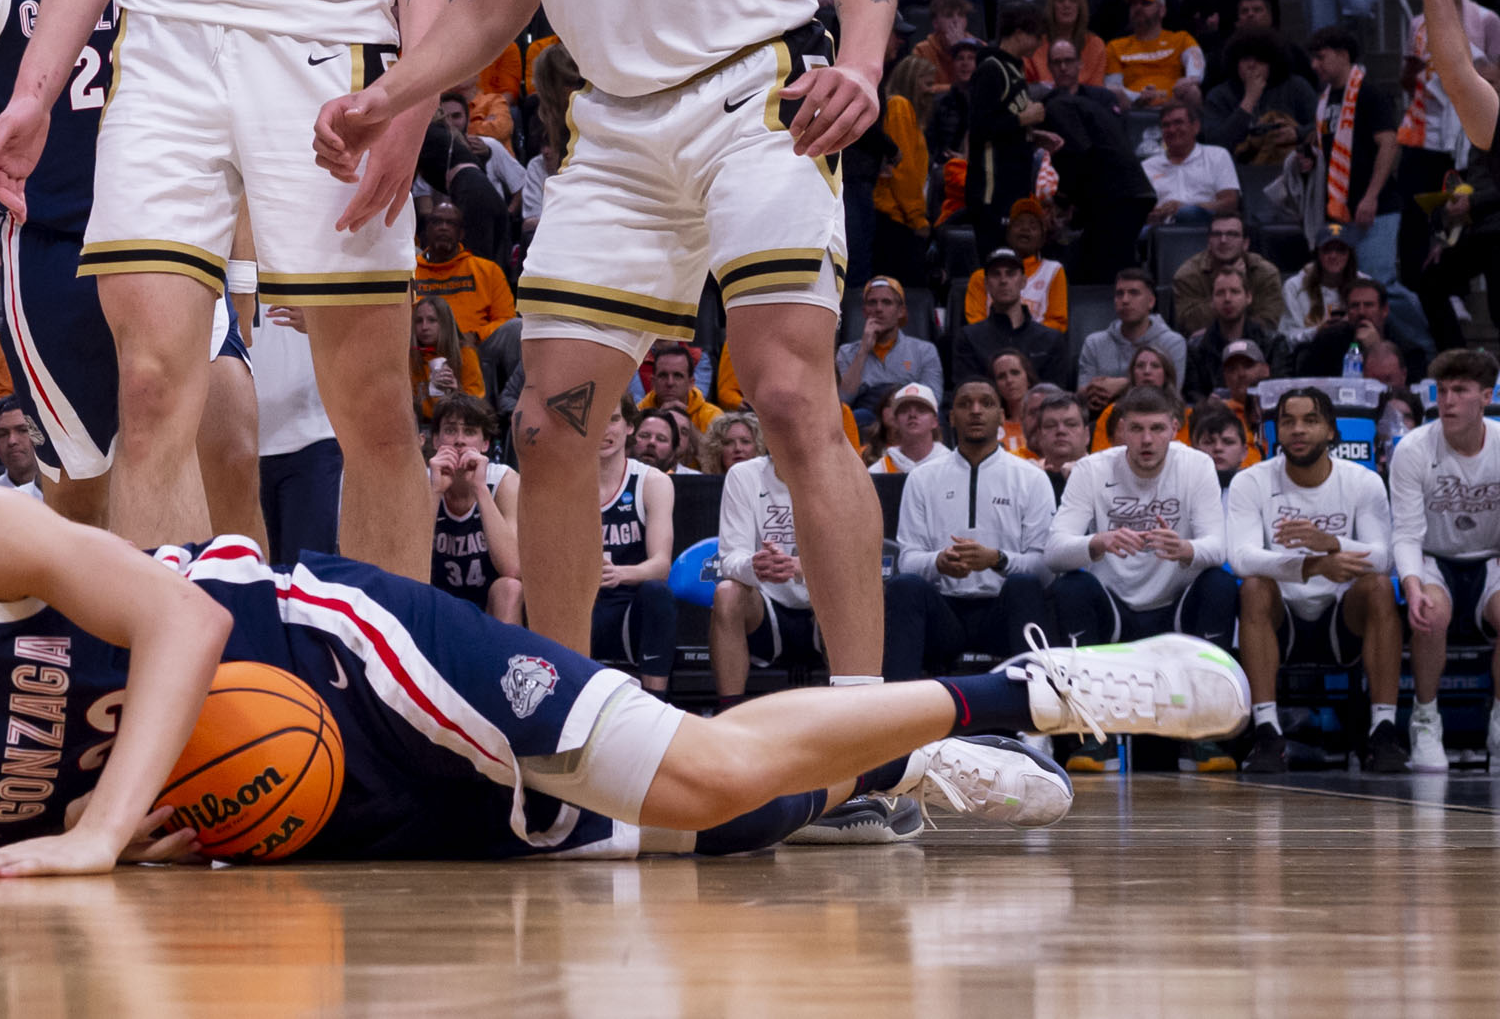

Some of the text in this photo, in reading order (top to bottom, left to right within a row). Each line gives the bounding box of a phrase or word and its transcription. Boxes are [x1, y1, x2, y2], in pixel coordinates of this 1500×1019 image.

[70, 45, 112, 111] 2
[1107, 497, 1181, 520] ZAGS
[436, 530, 488, 557] ONZAG
[602, 521, 642, 545] ZAGA
[444, 558, 487, 588] 34
